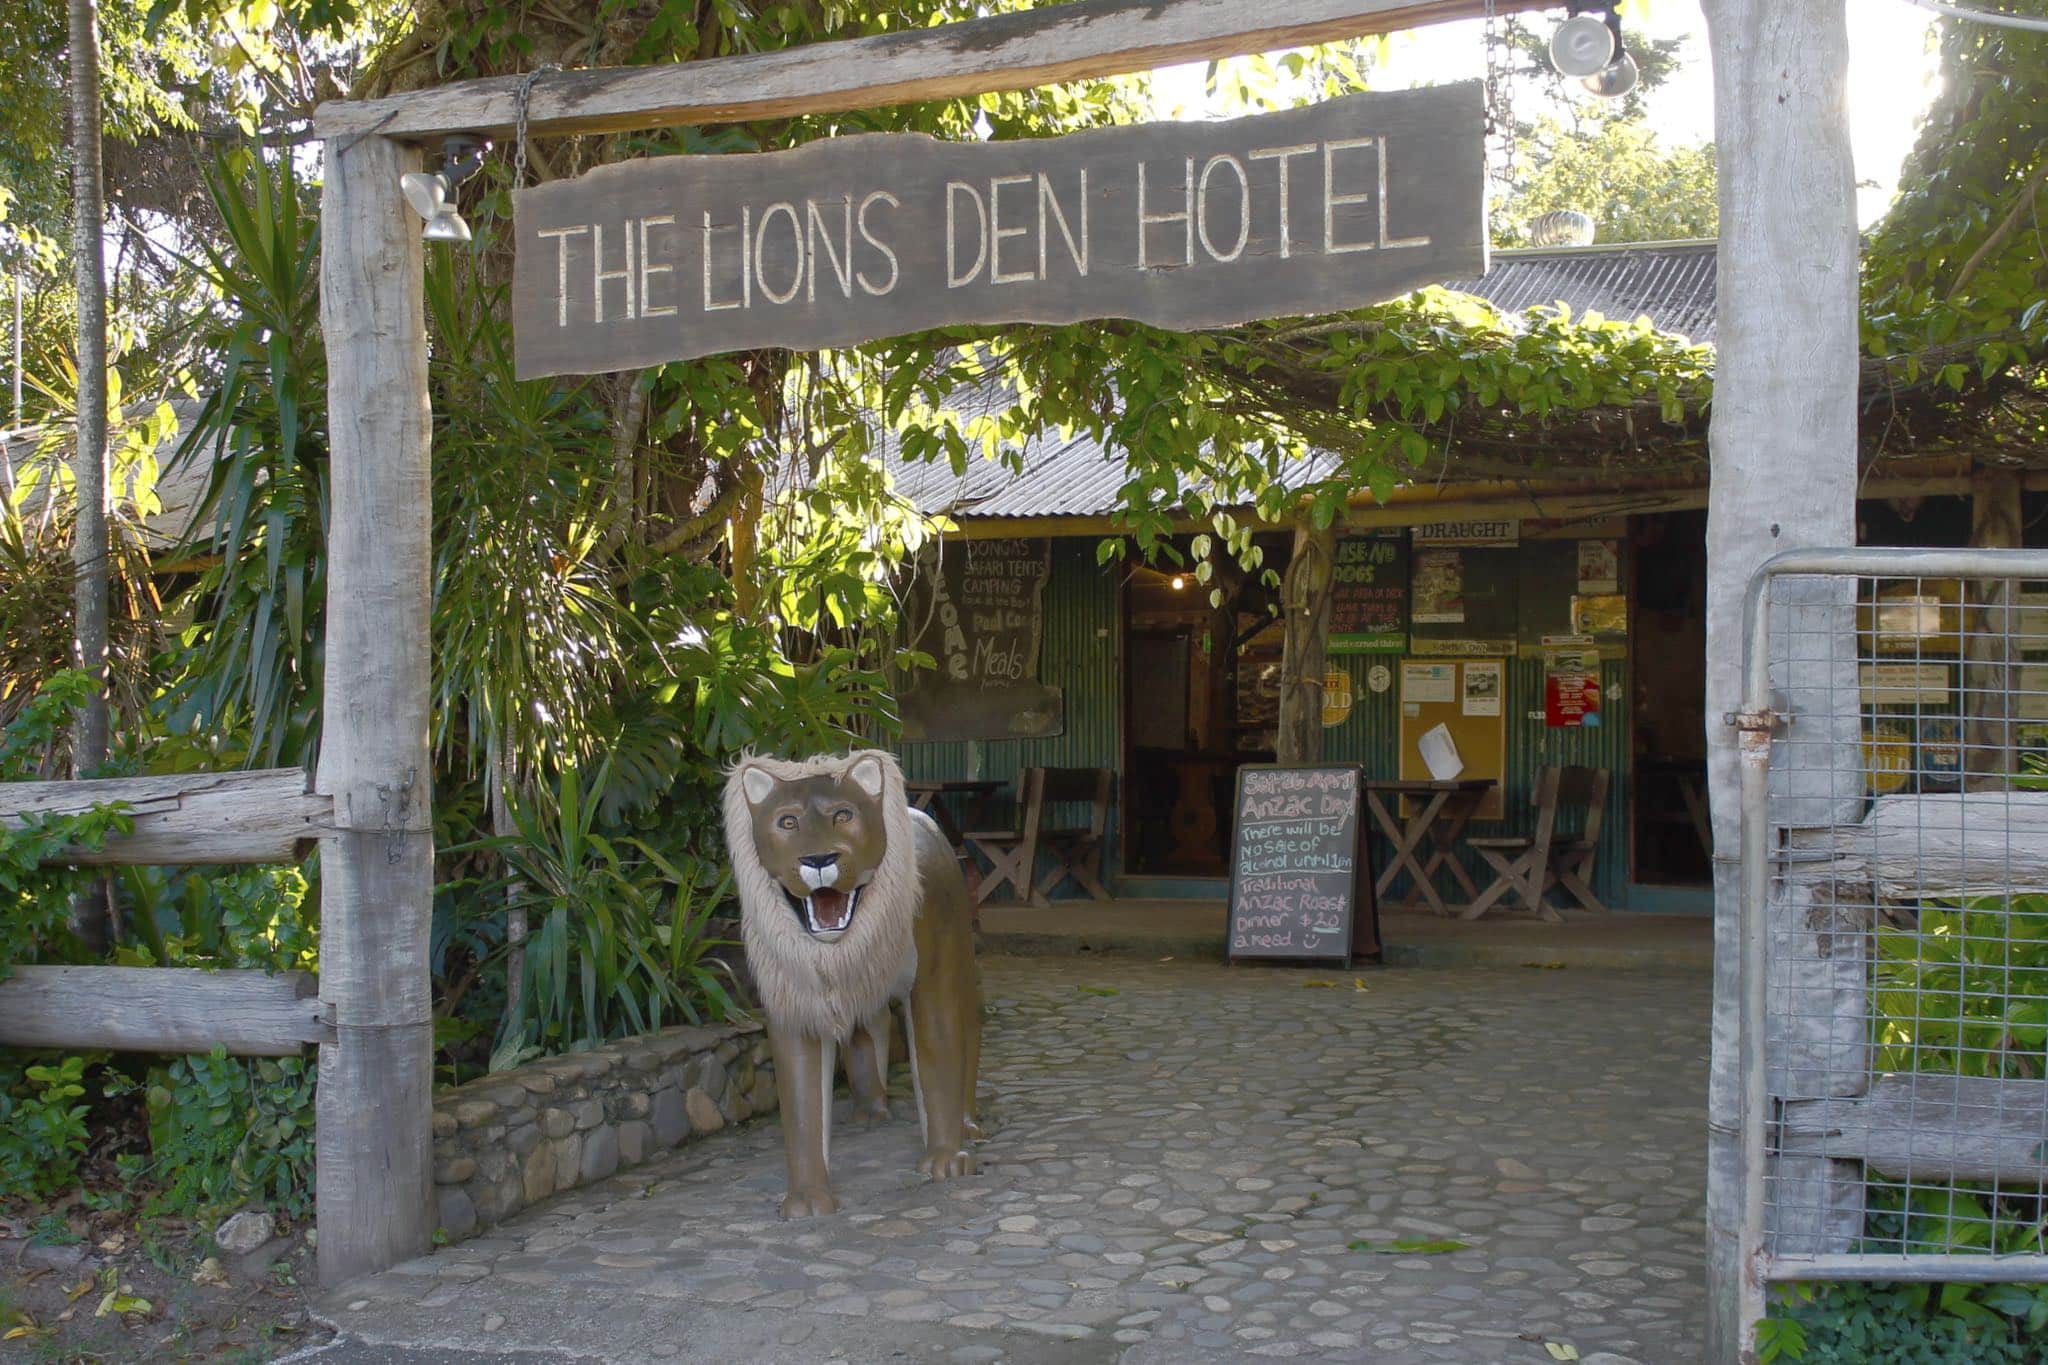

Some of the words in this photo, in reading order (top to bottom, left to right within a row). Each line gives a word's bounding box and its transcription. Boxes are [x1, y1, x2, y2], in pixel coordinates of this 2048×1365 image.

[538, 215, 678, 327] THE
[704, 190, 901, 313] LIONS
[946, 168, 1088, 288] DEN
[1138, 136, 1431, 270] HOTEL
[1422, 522, 1510, 538] DRAUGHT
[963, 560, 1004, 577] SAFARI
[1008, 559, 1045, 577] TENTS
[962, 578, 1022, 594] CAMPING
[973, 636, 1023, 679] Meals
[1322, 692, 1353, 709] OLD
[1241, 796, 1313, 819] Anzac
[1241, 825, 1282, 841] There
[1286, 821, 1312, 836] will
[1319, 822, 1343, 836] be
[1299, 836, 1321, 853] of
[1239, 875, 1320, 893] Traditional
[1299, 893, 1347, 912] Roast
[1236, 913, 1289, 932] Dinner
